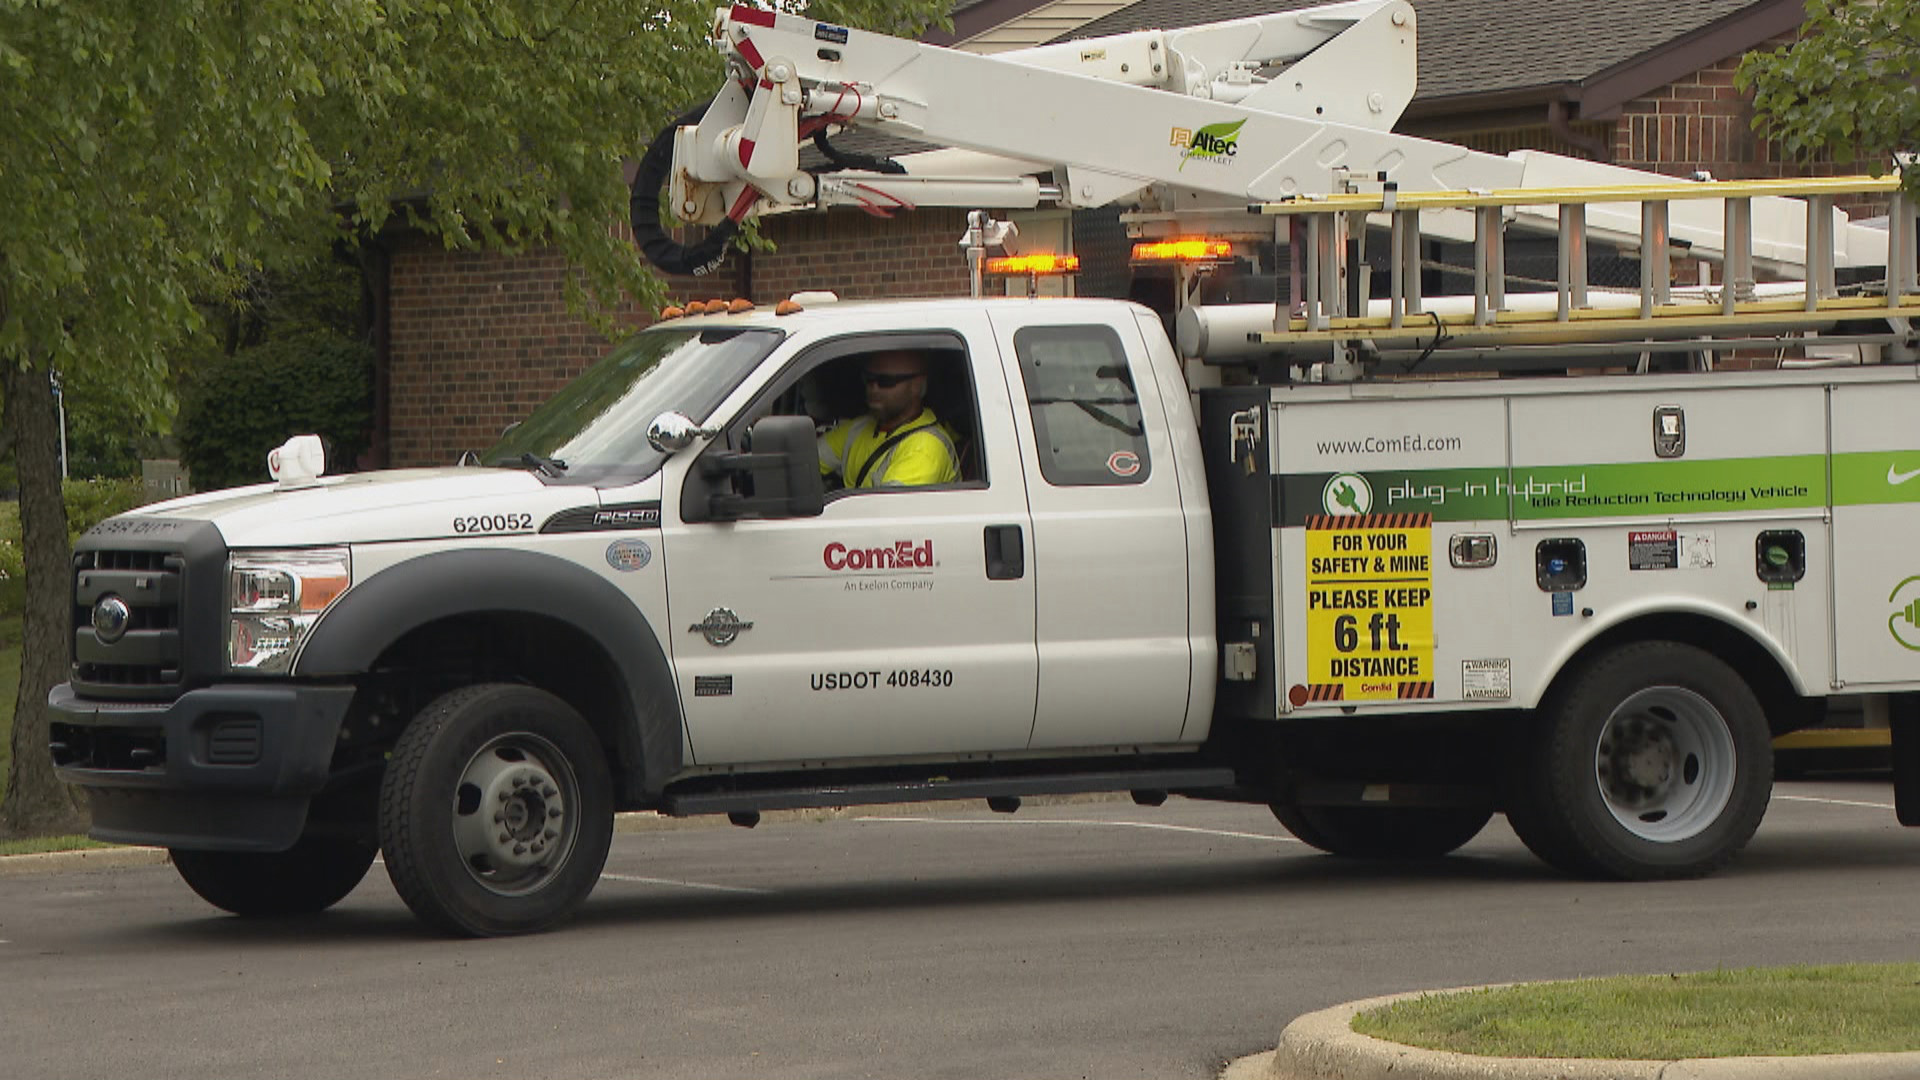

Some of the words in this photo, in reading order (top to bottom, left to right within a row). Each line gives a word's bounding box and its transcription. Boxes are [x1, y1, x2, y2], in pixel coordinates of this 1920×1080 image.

[1191, 131, 1238, 157] Altec
[1316, 434, 1462, 455] www.ComEd.com
[1388, 479, 1487, 505] plug-in
[1495, 473, 1586, 502] hybrid
[1532, 495, 1561, 508] Idle
[1566, 492, 1649, 507] Reduction
[1654, 489, 1746, 503] Technology
[1750, 485, 1808, 498] Vehicle
[453, 513, 534, 533] 620052
[1333, 535, 1363, 551] FOR
[1367, 533, 1407, 551] YOUR
[1641, 532, 1673, 541] DANGER
[823, 540, 934, 571] ComEd
[1311, 557, 1369, 574] SAFETY
[1373, 557, 1386, 573] &
[1390, 555, 1429, 572] MINE
[844, 581, 857, 591] An
[859, 580, 889, 591] Exelon
[891, 579, 934, 592] Company
[1309, 589, 1379, 609] PLEASE
[1384, 588, 1431, 608] KEEP
[1334, 614, 1359, 652] 6
[1368, 613, 1409, 651] ft.
[1331, 657, 1419, 677] DISTANCE
[1472, 660, 1508, 669] WARNING
[811, 672, 881, 691] USDOT
[886, 669, 953, 688] 408430
